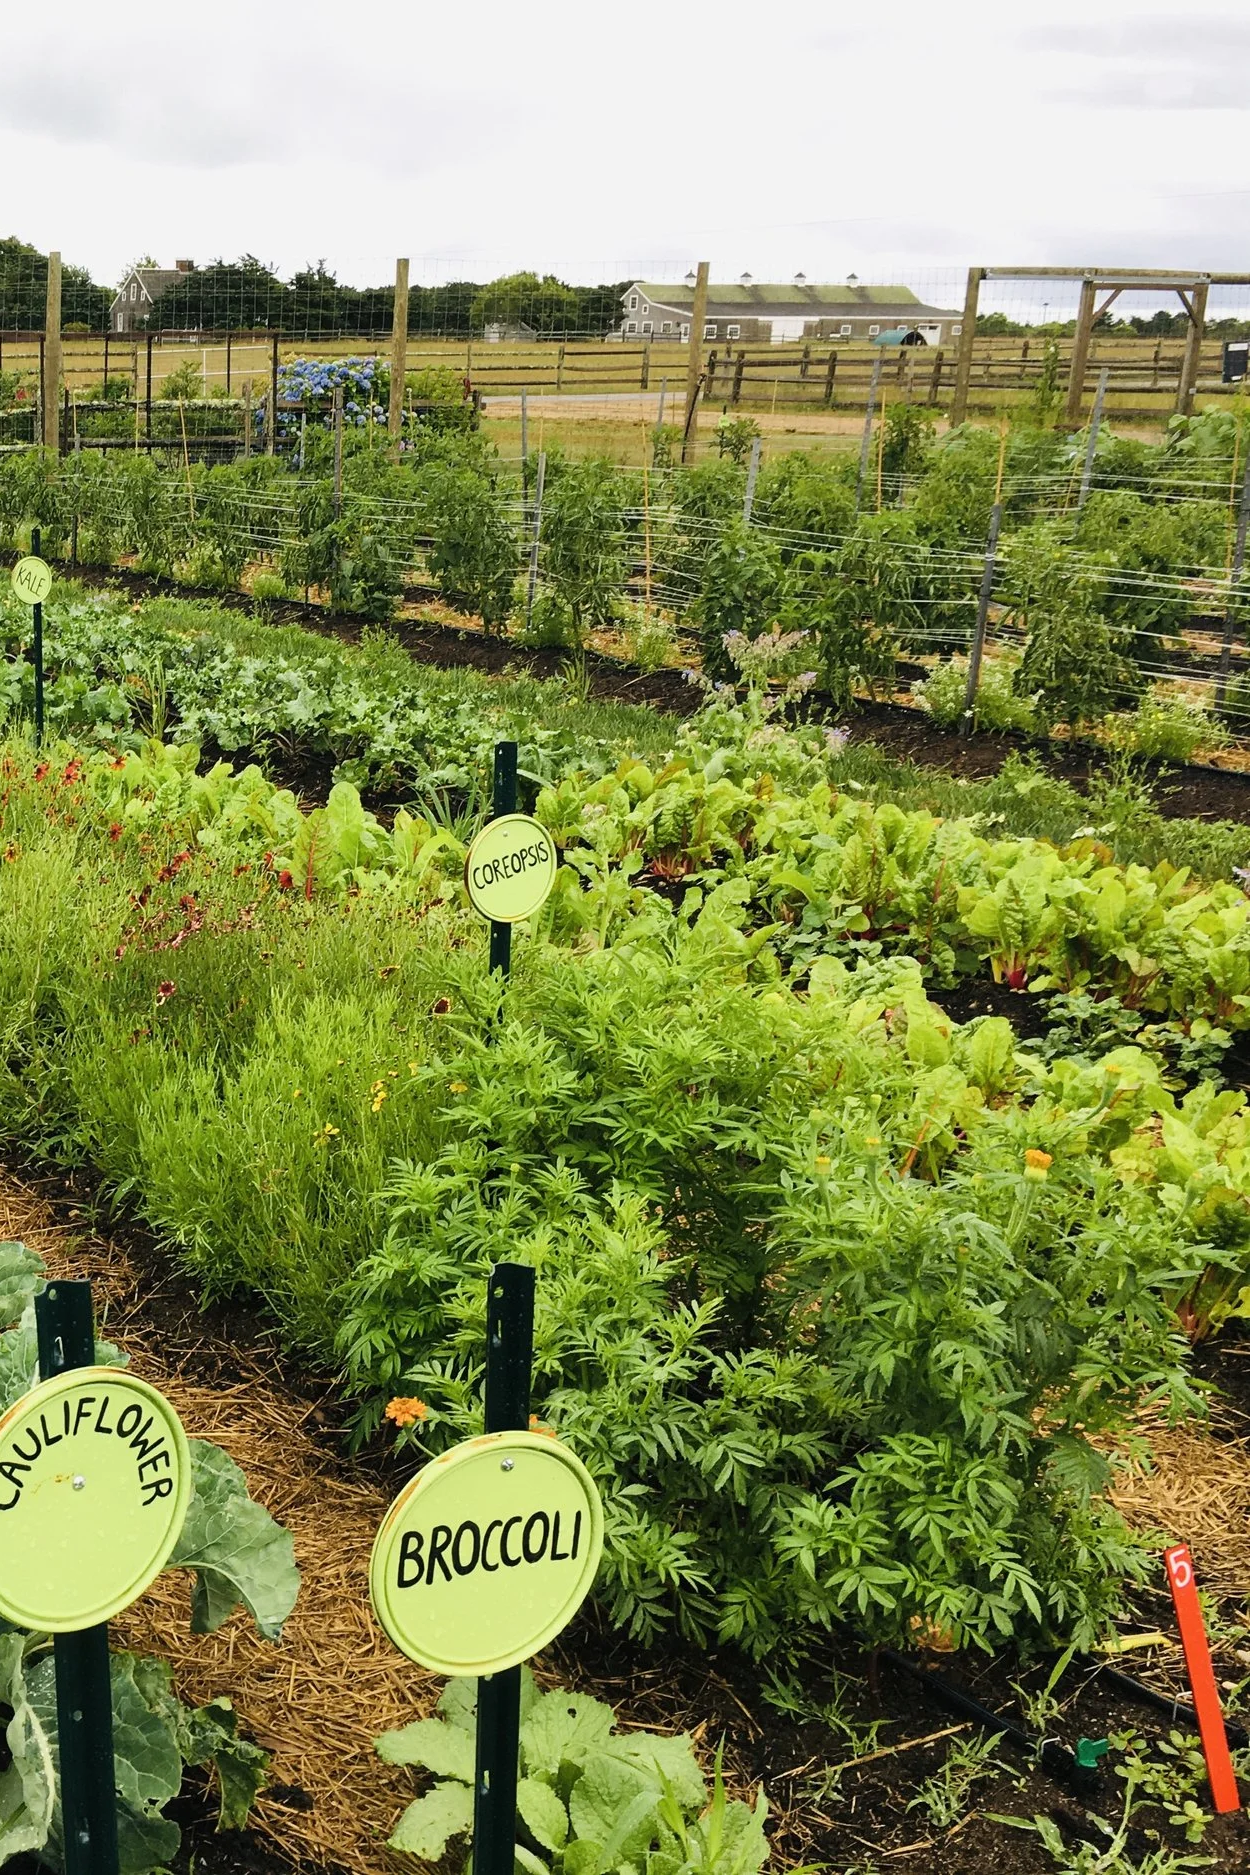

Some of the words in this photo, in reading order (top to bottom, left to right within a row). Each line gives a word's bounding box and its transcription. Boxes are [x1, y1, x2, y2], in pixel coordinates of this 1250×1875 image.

[16, 566, 46, 597] KALE
[473, 841, 548, 889] COREOPSIS
[397, 1510, 582, 1588] BROCCOLI
[1169, 1549, 1192, 1588] 5
